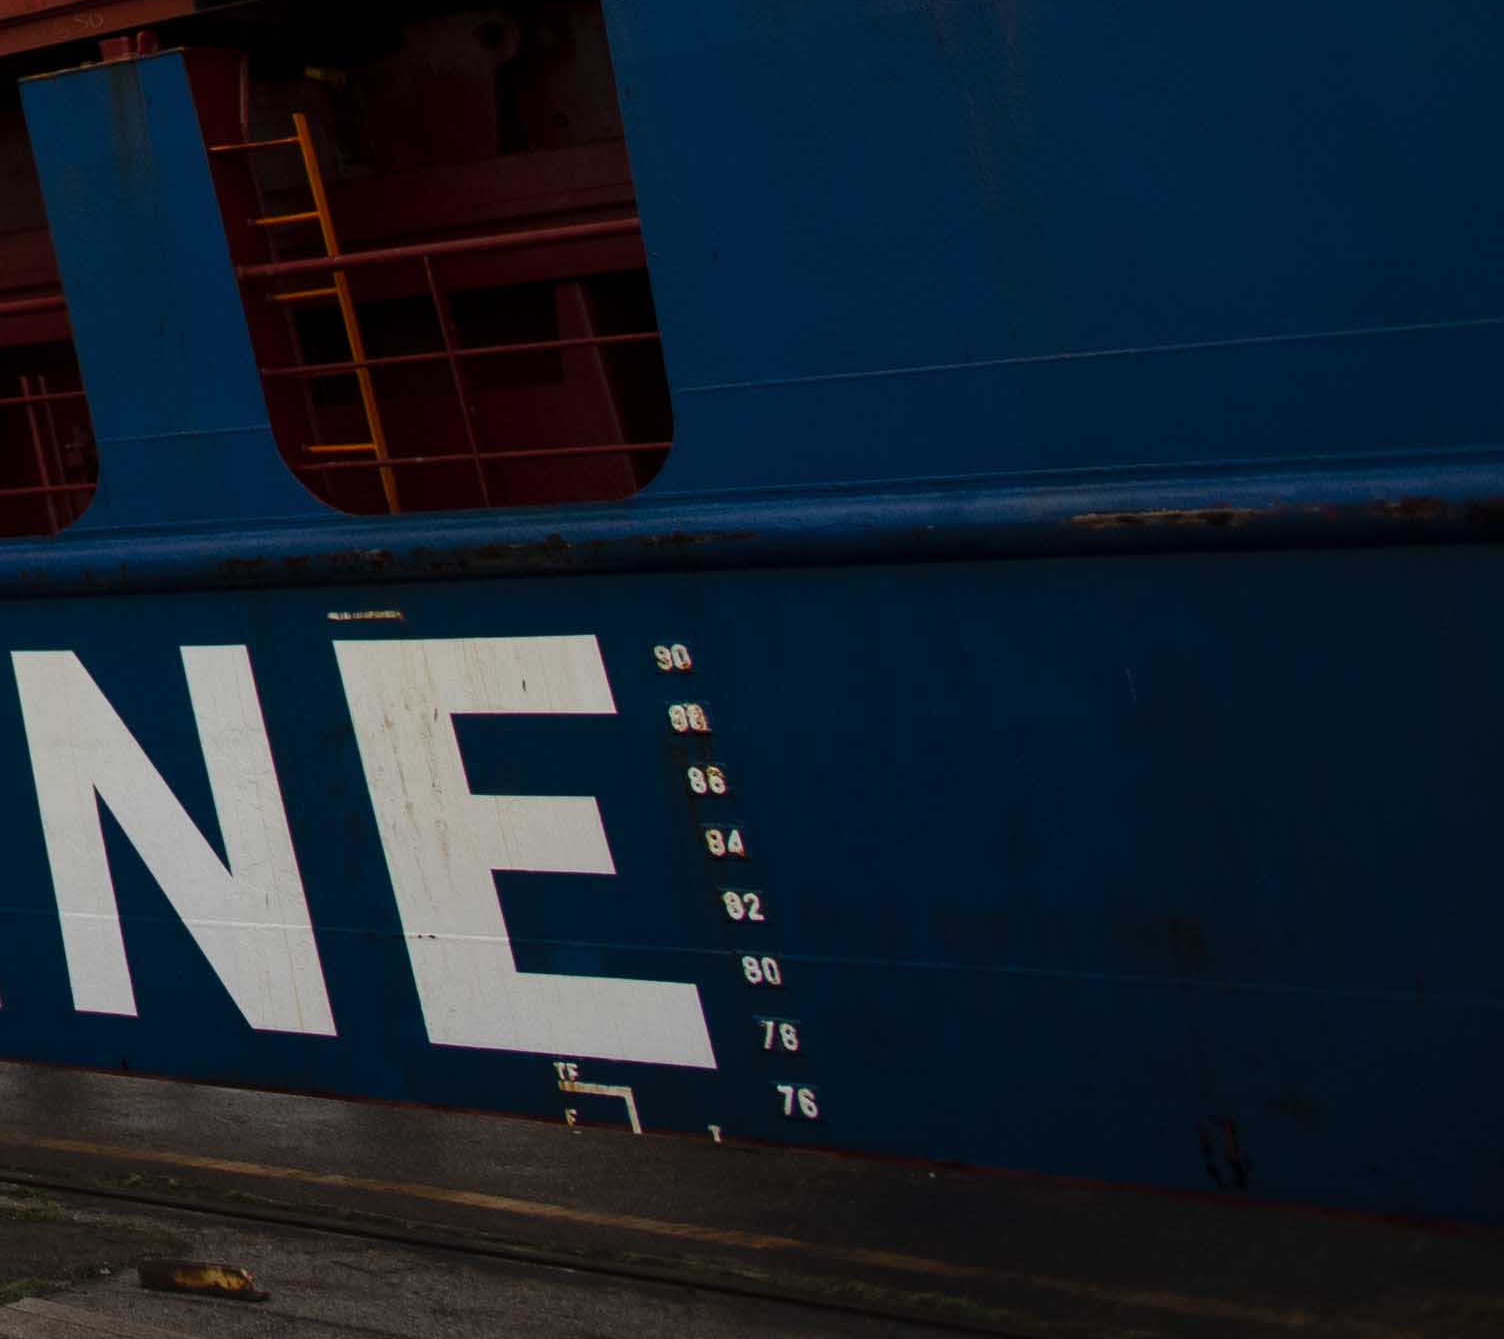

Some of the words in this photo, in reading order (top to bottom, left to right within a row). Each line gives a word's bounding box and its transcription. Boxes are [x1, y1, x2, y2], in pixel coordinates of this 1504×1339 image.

[653, 643, 691, 671] 90
[688, 766, 728, 795] 86
[705, 828, 745, 857] 84
[722, 891, 765, 921] 82
[742, 956, 782, 986] 80
[761, 1021, 800, 1052] 78
[777, 1085, 819, 1119] 76
